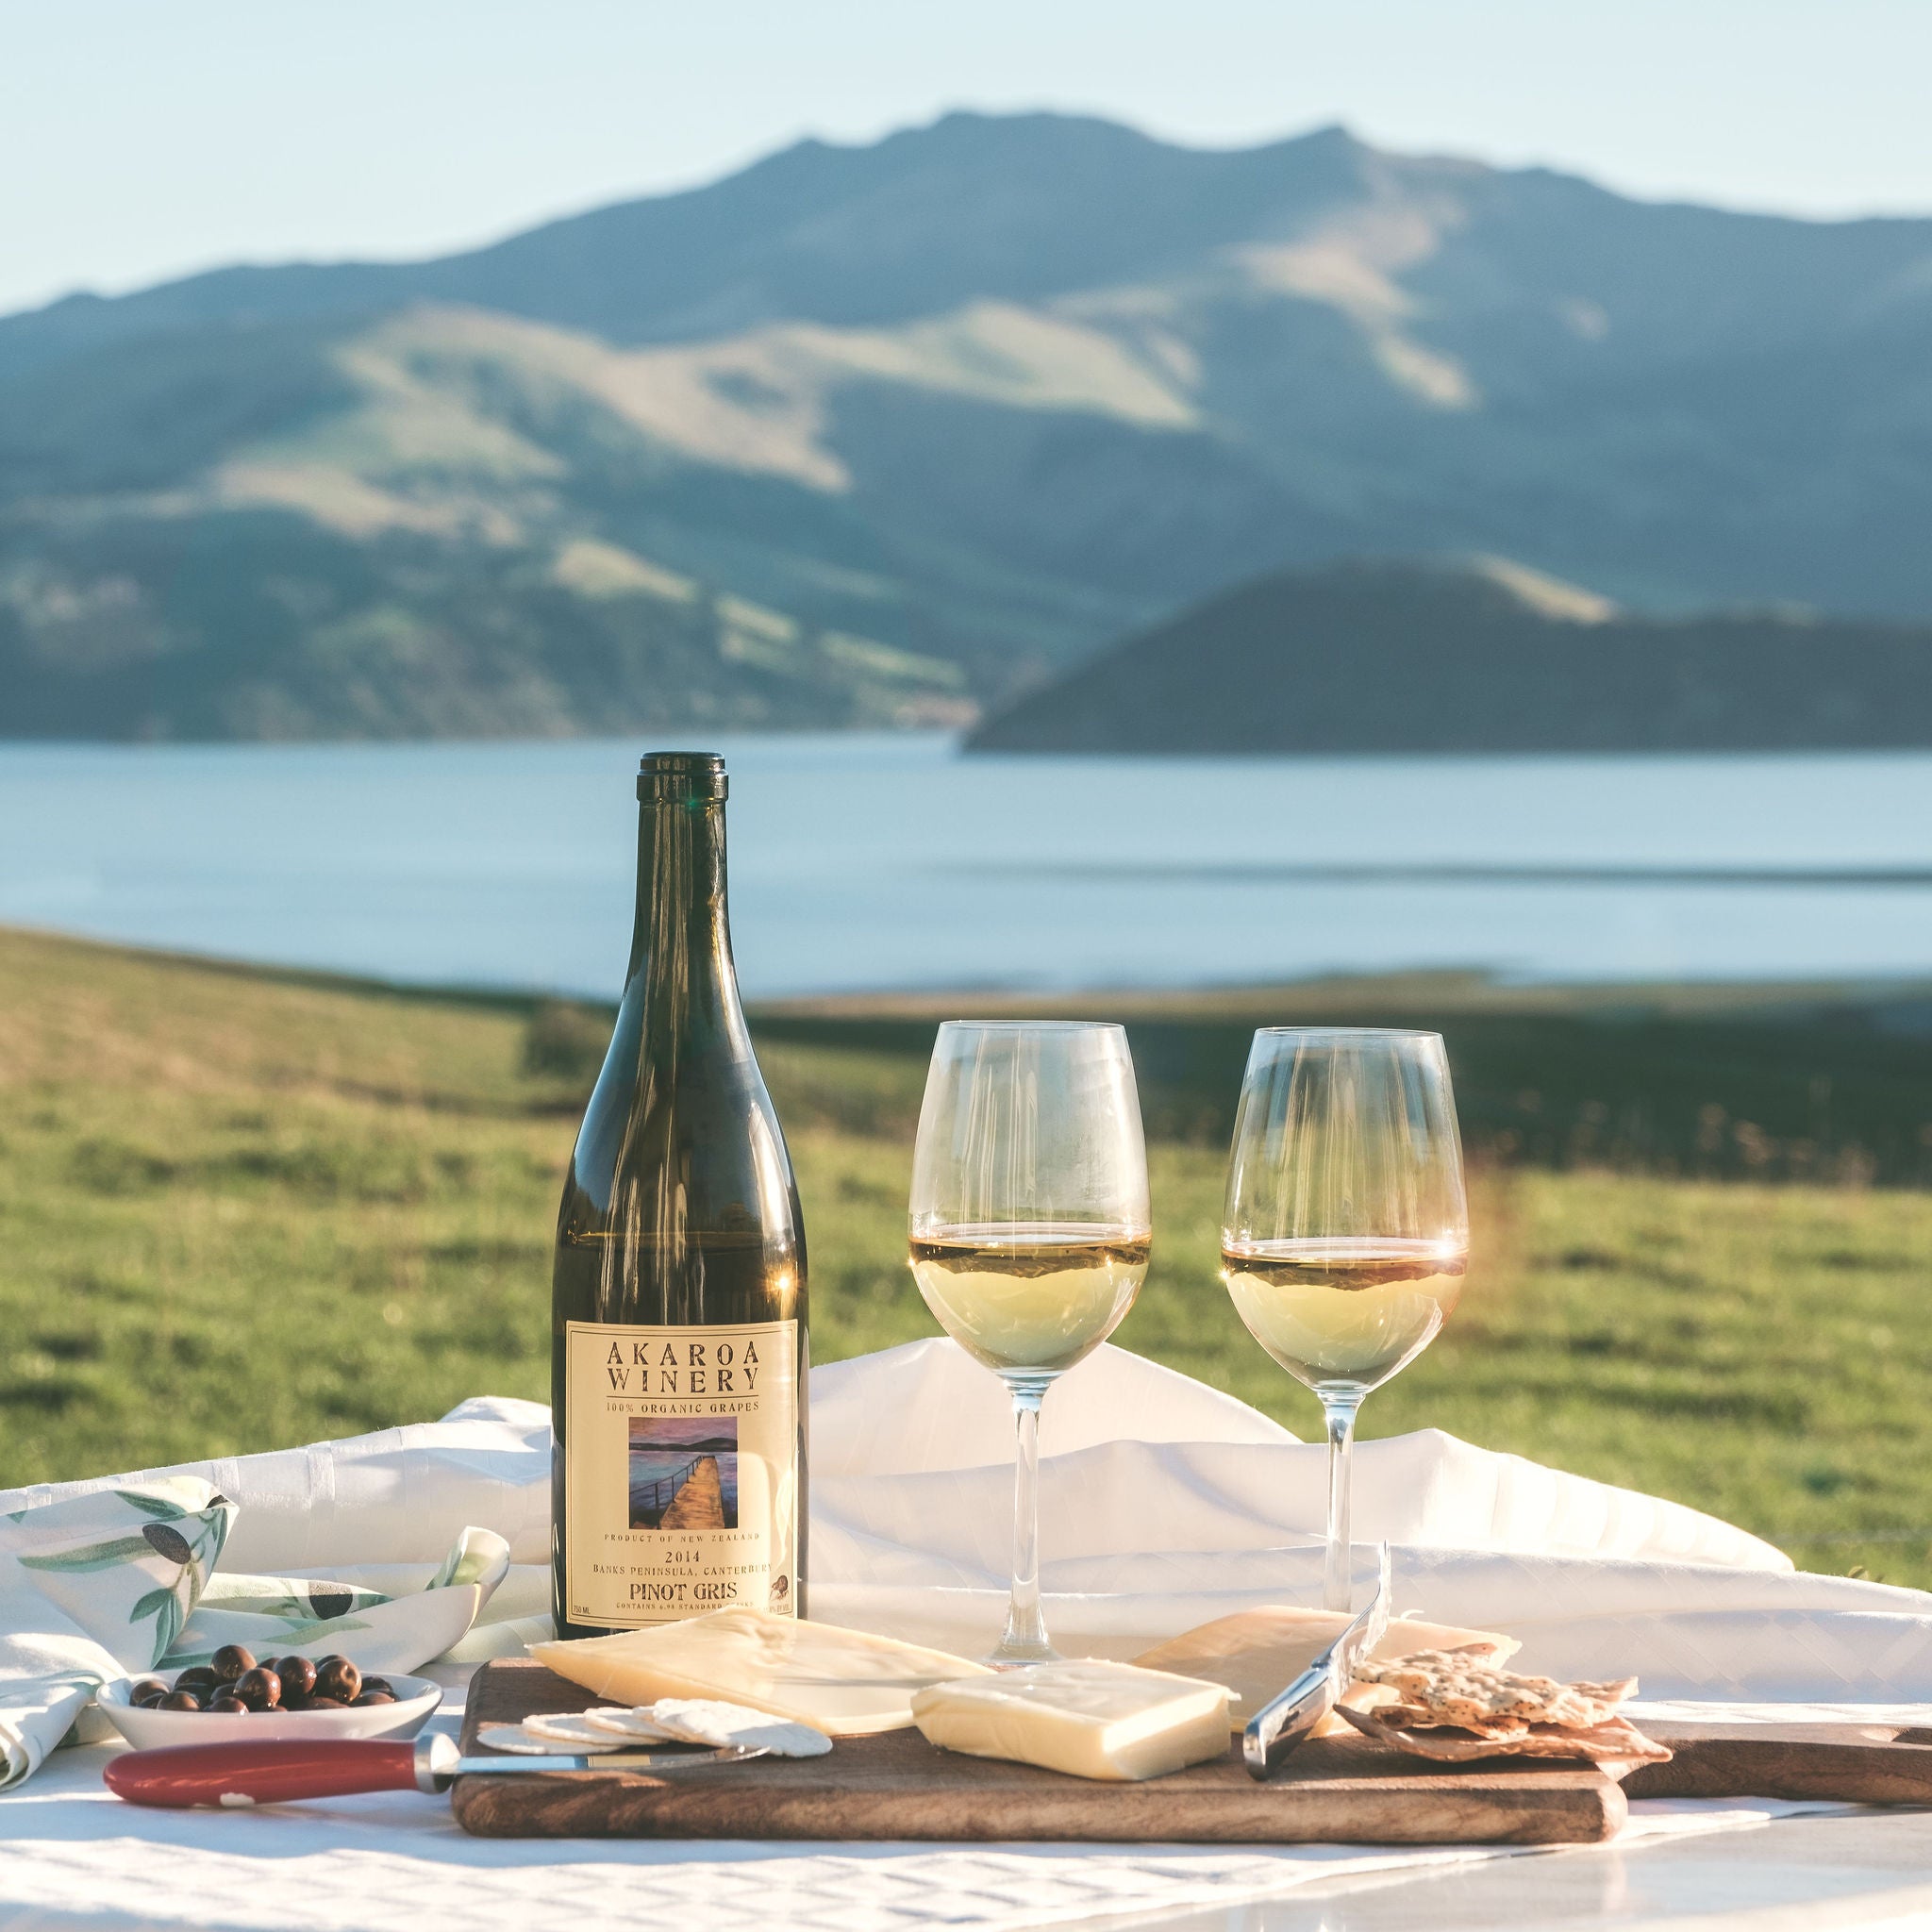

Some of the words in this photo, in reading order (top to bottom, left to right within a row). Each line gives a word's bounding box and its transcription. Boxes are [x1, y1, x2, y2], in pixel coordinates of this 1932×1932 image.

[607, 1341, 758, 1366] AKAROA
[607, 1367, 758, 1393] WINERY
[606, 1402, 634, 1413] 100%
[641, 1403, 702, 1414] ORGANIC
[710, 1401, 759, 1413] GRAPES
[604, 1534, 652, 1542] PRODUCT
[711, 1534, 759, 1542] ZEALAND
[665, 1550, 700, 1563] 2014
[593, 1564, 625, 1574] BANKS
[630, 1567, 697, 1576] PENINSULA,
[704, 1563, 773, 1575] CANTERBURY
[629, 1583, 687, 1601] PINOT
[693, 1582, 738, 1600] GRIS
[573, 1606, 582, 1614] 750
